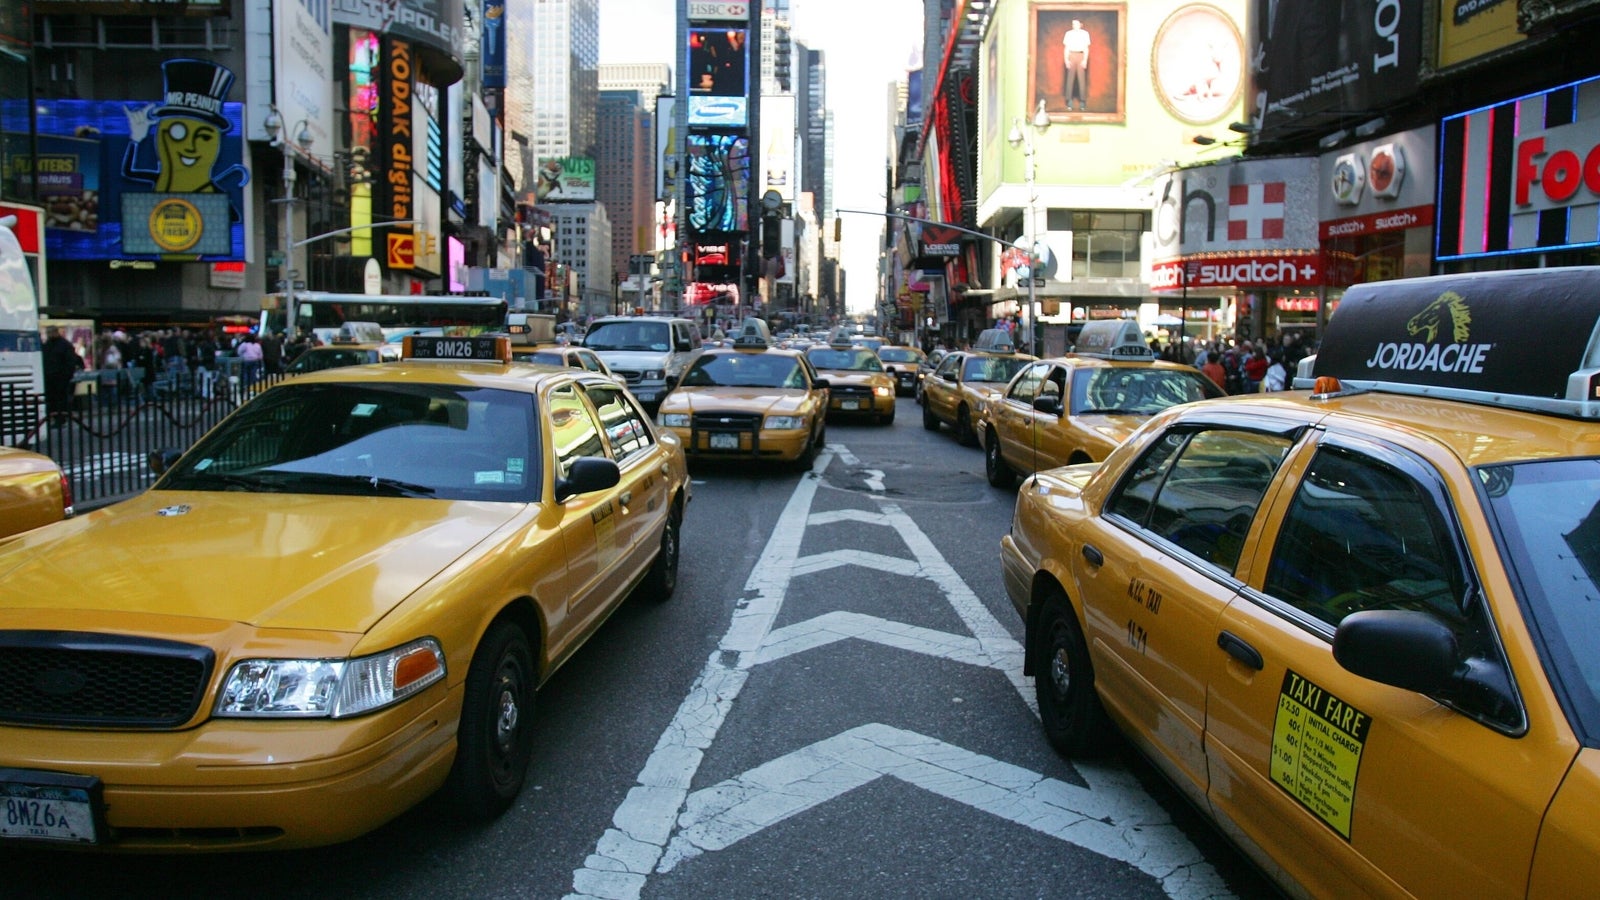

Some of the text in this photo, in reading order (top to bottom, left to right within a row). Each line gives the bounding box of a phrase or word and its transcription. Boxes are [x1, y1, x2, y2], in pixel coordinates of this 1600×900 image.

[690, 5, 725, 16] HSBC
[391, 39, 410, 136] KODAK
[166, 92, 222, 112] MR. PEANUT
[388, 142, 412, 228] digital
[1328, 220, 1360, 236] swatch
[1375, 213, 1411, 230] swatch
[1200, 260, 1297, 283] swatch
[436, 341, 472, 357] 8M26
[1366, 342, 1492, 374] JORDACHE
[1146, 588, 1162, 615] TAXI
[1290, 674, 1364, 737] TAXI FARE
[1306, 731, 1314, 740] Per
[1308, 716, 1360, 755] INITIAL CHARGE
[29, 828, 49, 836] TAXI
